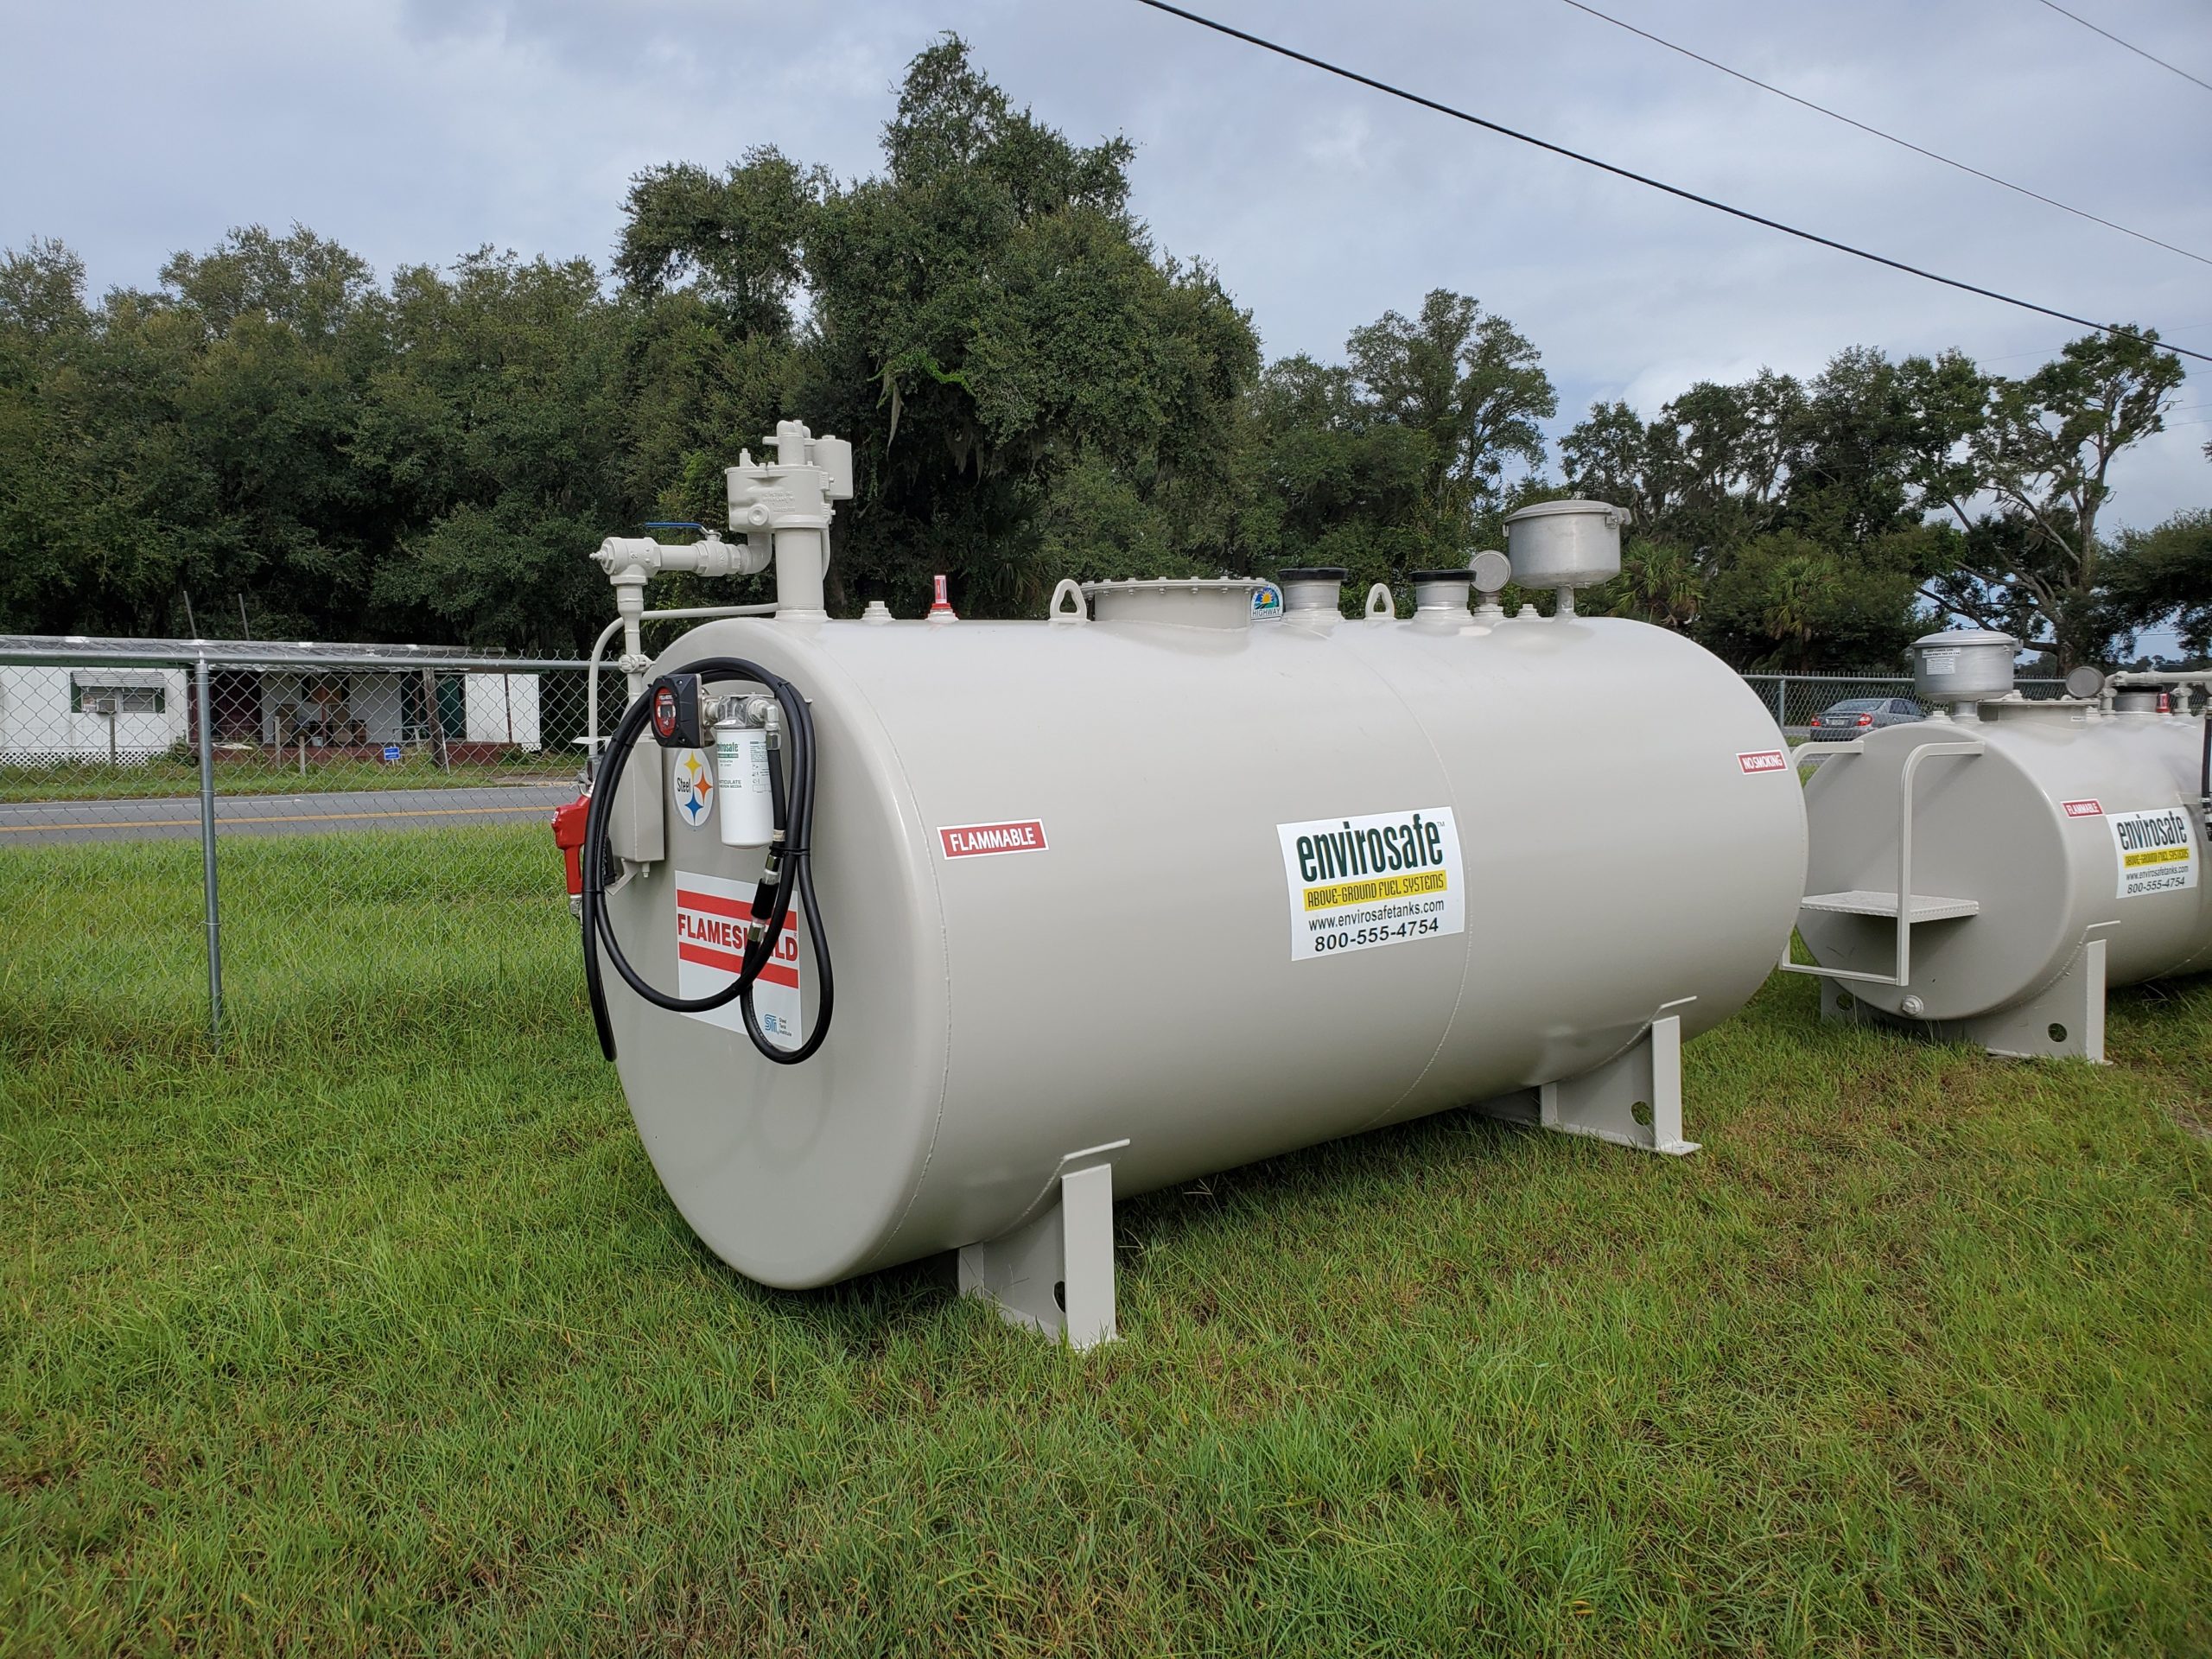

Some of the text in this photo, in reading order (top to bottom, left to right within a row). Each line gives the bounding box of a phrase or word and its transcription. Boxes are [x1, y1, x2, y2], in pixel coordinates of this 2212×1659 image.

[1253, 607, 1280, 617] HIGHWAY
[1742, 754, 1783, 769] NO SMOKING
[677, 777, 691, 793] Steel
[950, 827, 1036, 852] FLAMMABLE
[2117, 810, 2187, 850] envirosafe
[1296, 813, 1443, 882] envirosafe
[2126, 866, 2189, 880] www.envirosafetanks.com
[2127, 876, 2185, 894] 800-555-4754
[1307, 873, 1444, 908] ABOVE-GROUND FUEL SYSTEMS
[1308, 899, 1445, 931] www.envirosafetanks.com
[677, 913, 798, 962] FLAMESLD
[1314, 918, 1439, 952] 800-555-4754
